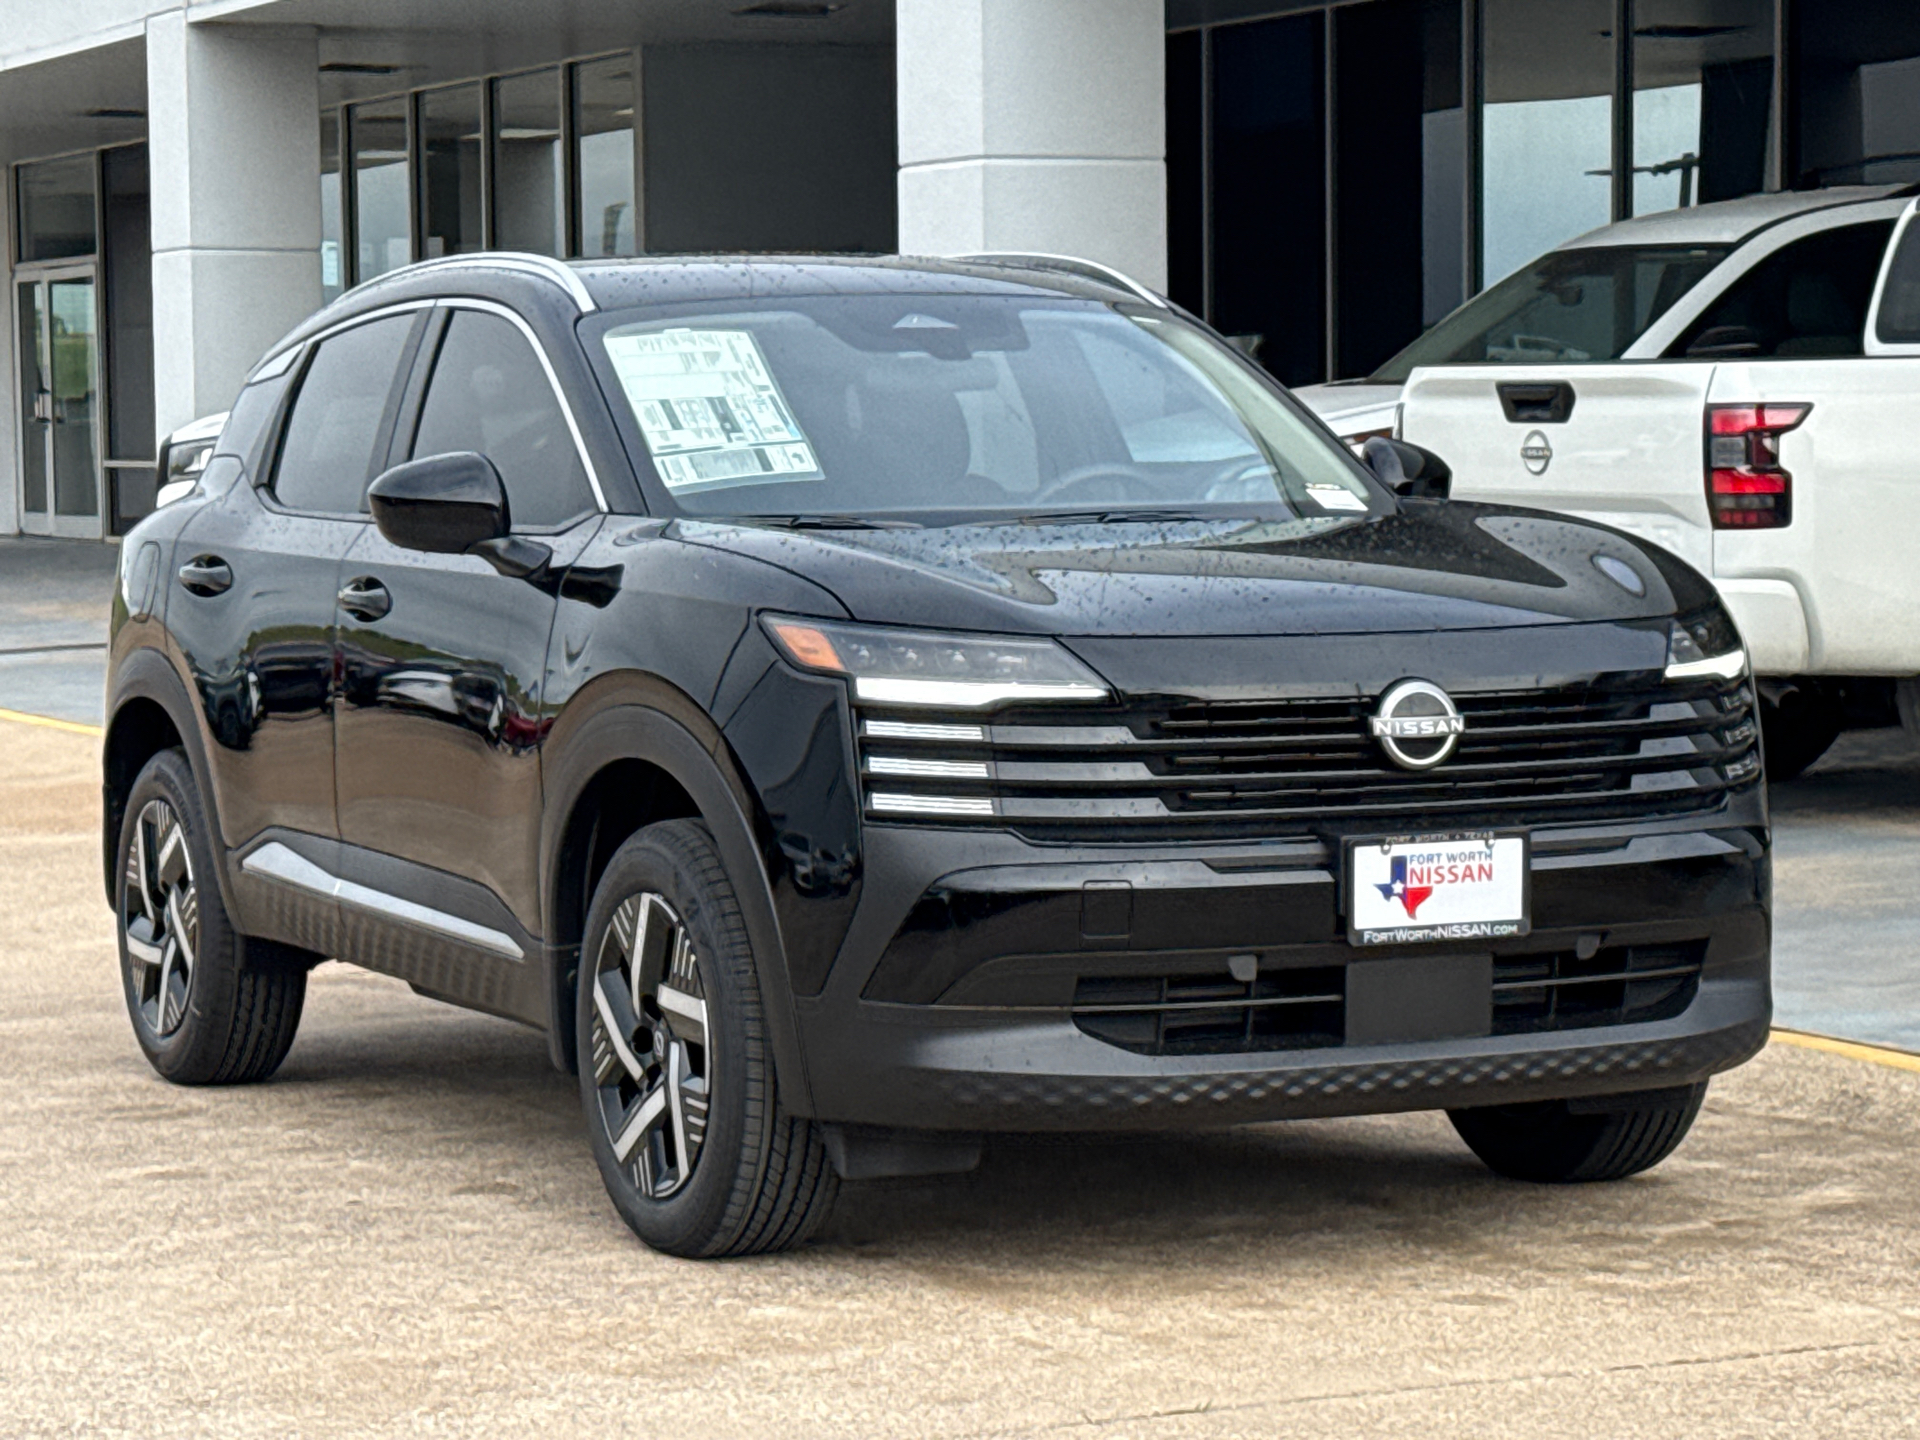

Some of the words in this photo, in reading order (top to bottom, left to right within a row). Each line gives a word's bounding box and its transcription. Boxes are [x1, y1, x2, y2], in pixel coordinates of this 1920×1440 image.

[1375, 719, 1464, 735] NISSAN
[1409, 853, 1442, 865] FORT
[1446, 851, 1493, 863] WORTH
[1409, 863, 1493, 885] NISSAN
